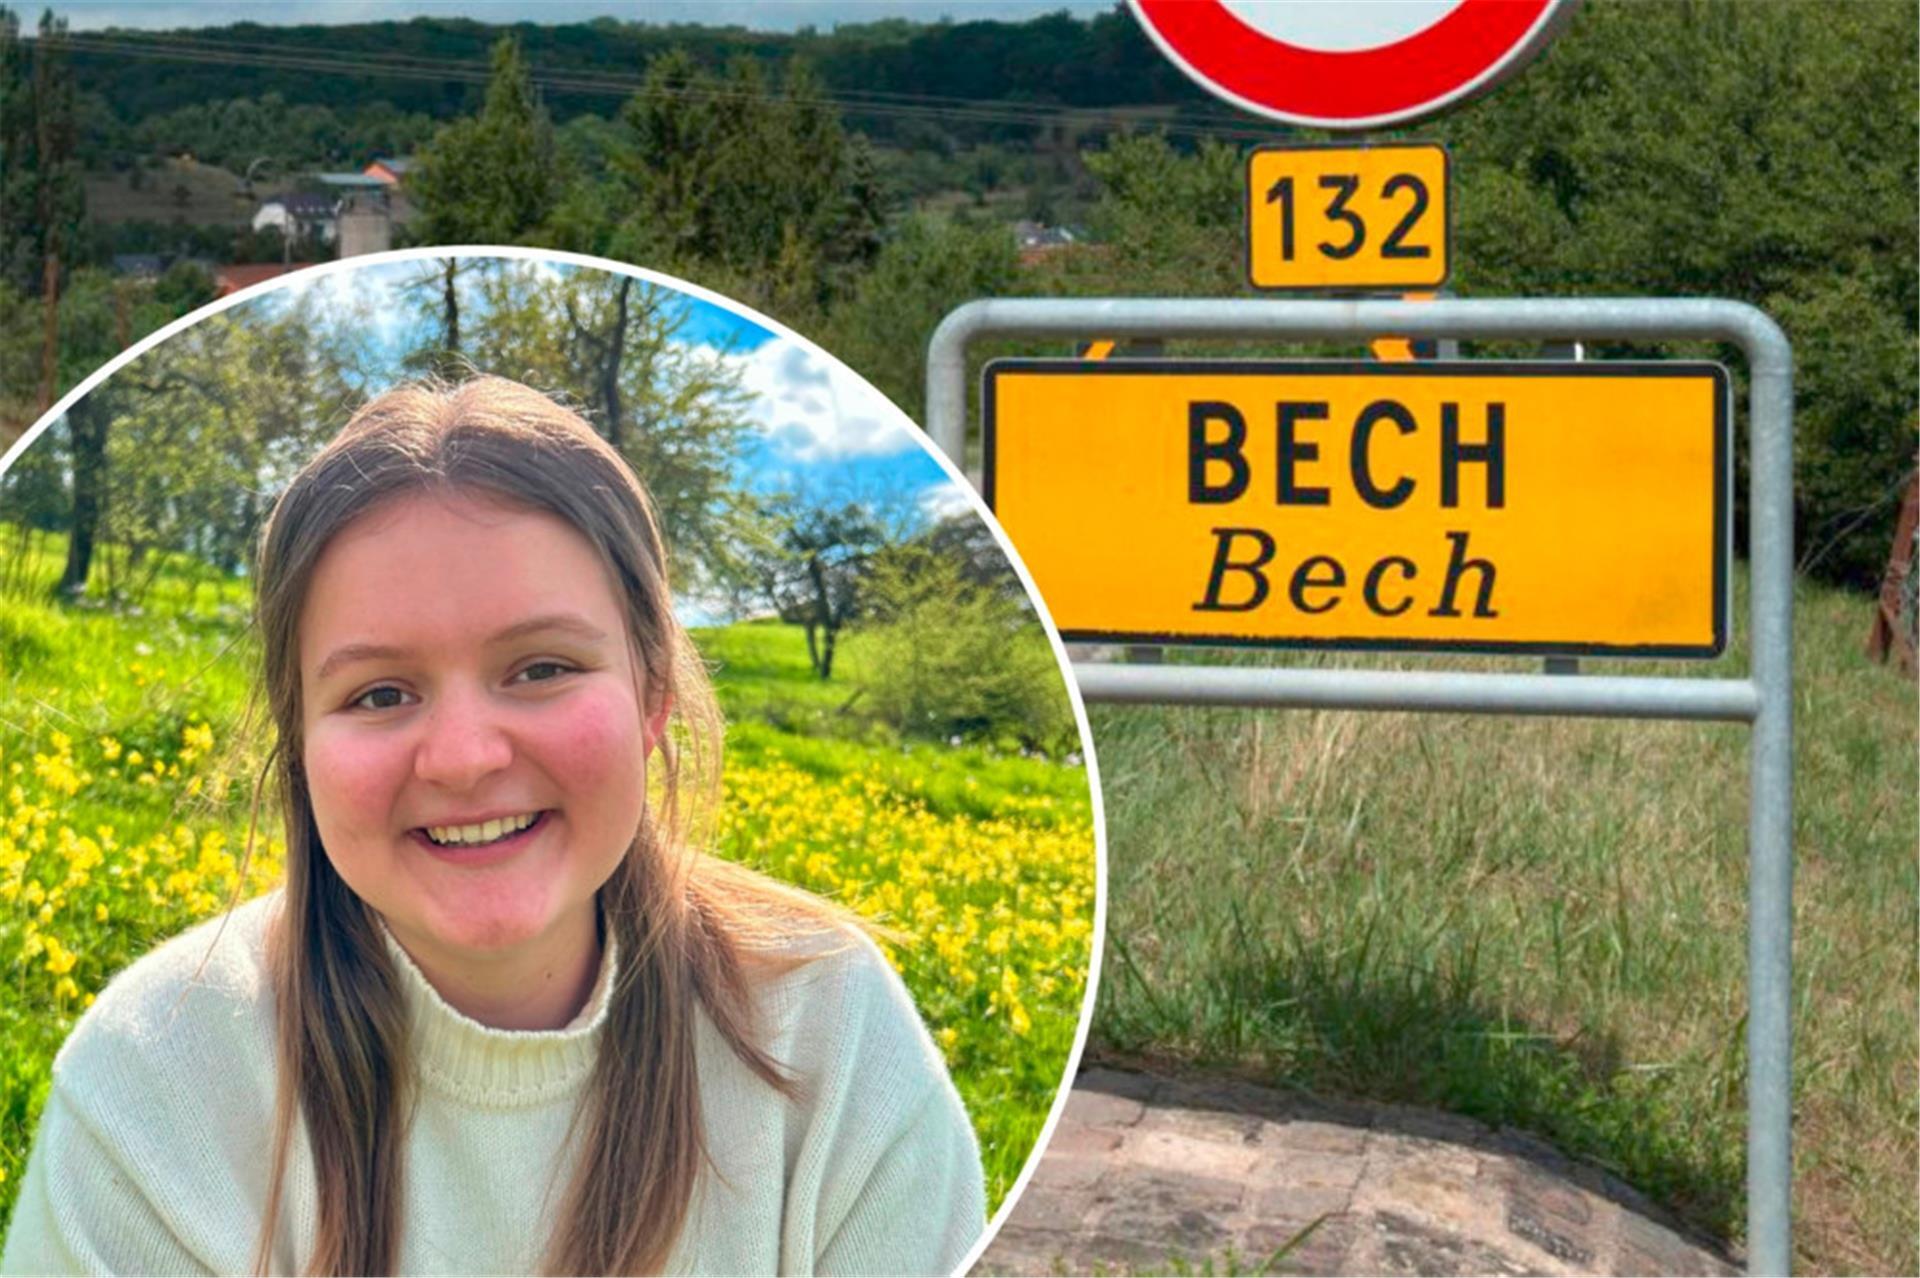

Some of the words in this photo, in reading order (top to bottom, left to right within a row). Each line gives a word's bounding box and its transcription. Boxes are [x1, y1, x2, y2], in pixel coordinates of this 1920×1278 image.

[1264, 173, 1432, 261] 132
[1187, 400, 1506, 510] BECH
[1191, 527, 1499, 619] Bech
